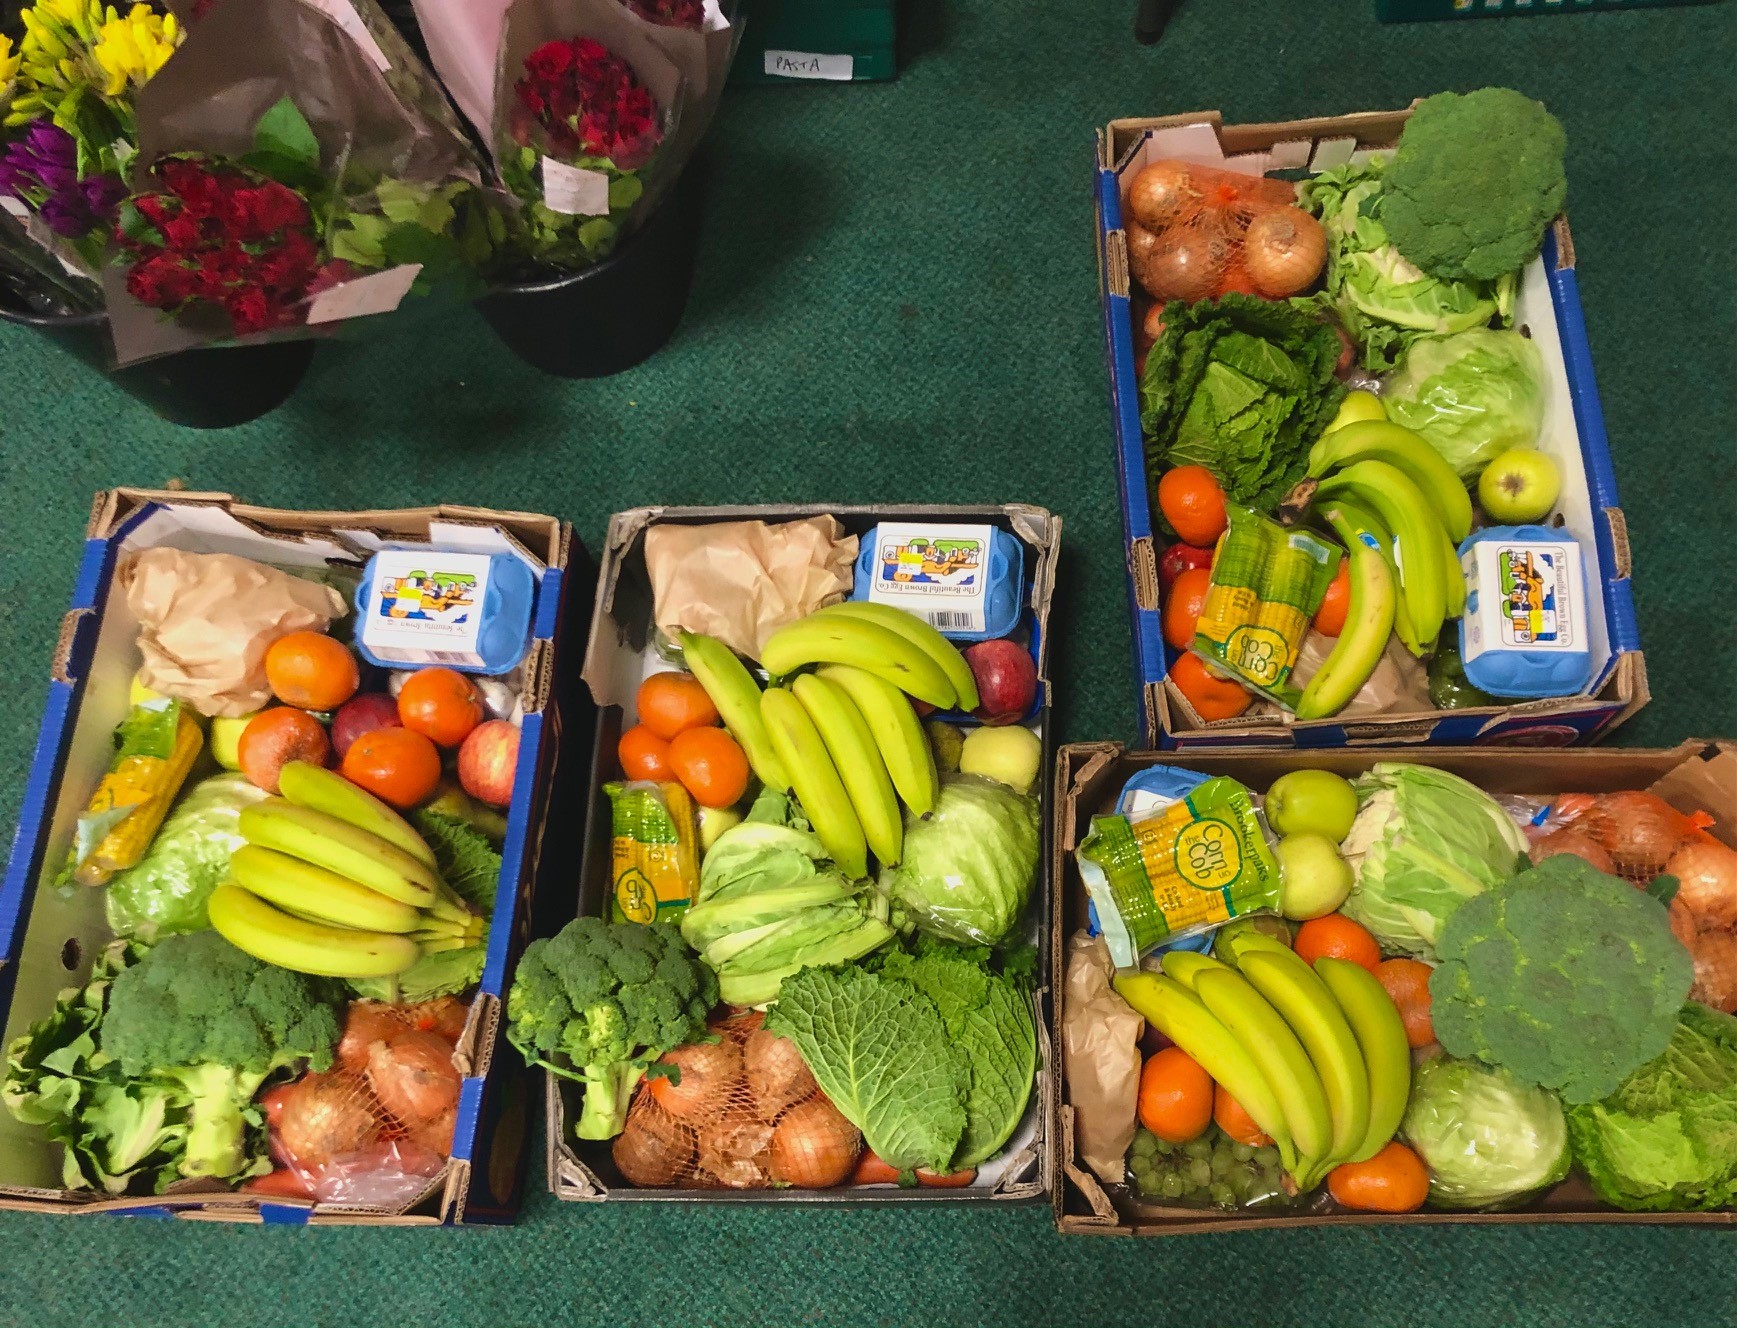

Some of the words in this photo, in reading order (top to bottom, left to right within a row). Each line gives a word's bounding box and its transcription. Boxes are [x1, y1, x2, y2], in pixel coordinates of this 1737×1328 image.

[1555, 552, 1564, 563] The
[890, 582, 904, 591] Egg
[905, 584, 928, 593] Brown
[1556, 565, 1567, 595] Beautiful
[929, 585, 961, 593] Beautiful
[962, 586, 976, 595] The
[1559, 597, 1568, 618] Brown
[1558, 620, 1569, 632] Egg
[1240, 634, 1274, 658] Cob
[1237, 656, 1279, 681] Corn
[1185, 833, 1200, 846] the
[1229, 797, 1270, 882] Brookerpaks
[1202, 824, 1229, 870] Corn
[1218, 868, 1231, 878] on
[1188, 842, 1212, 879] Cob
